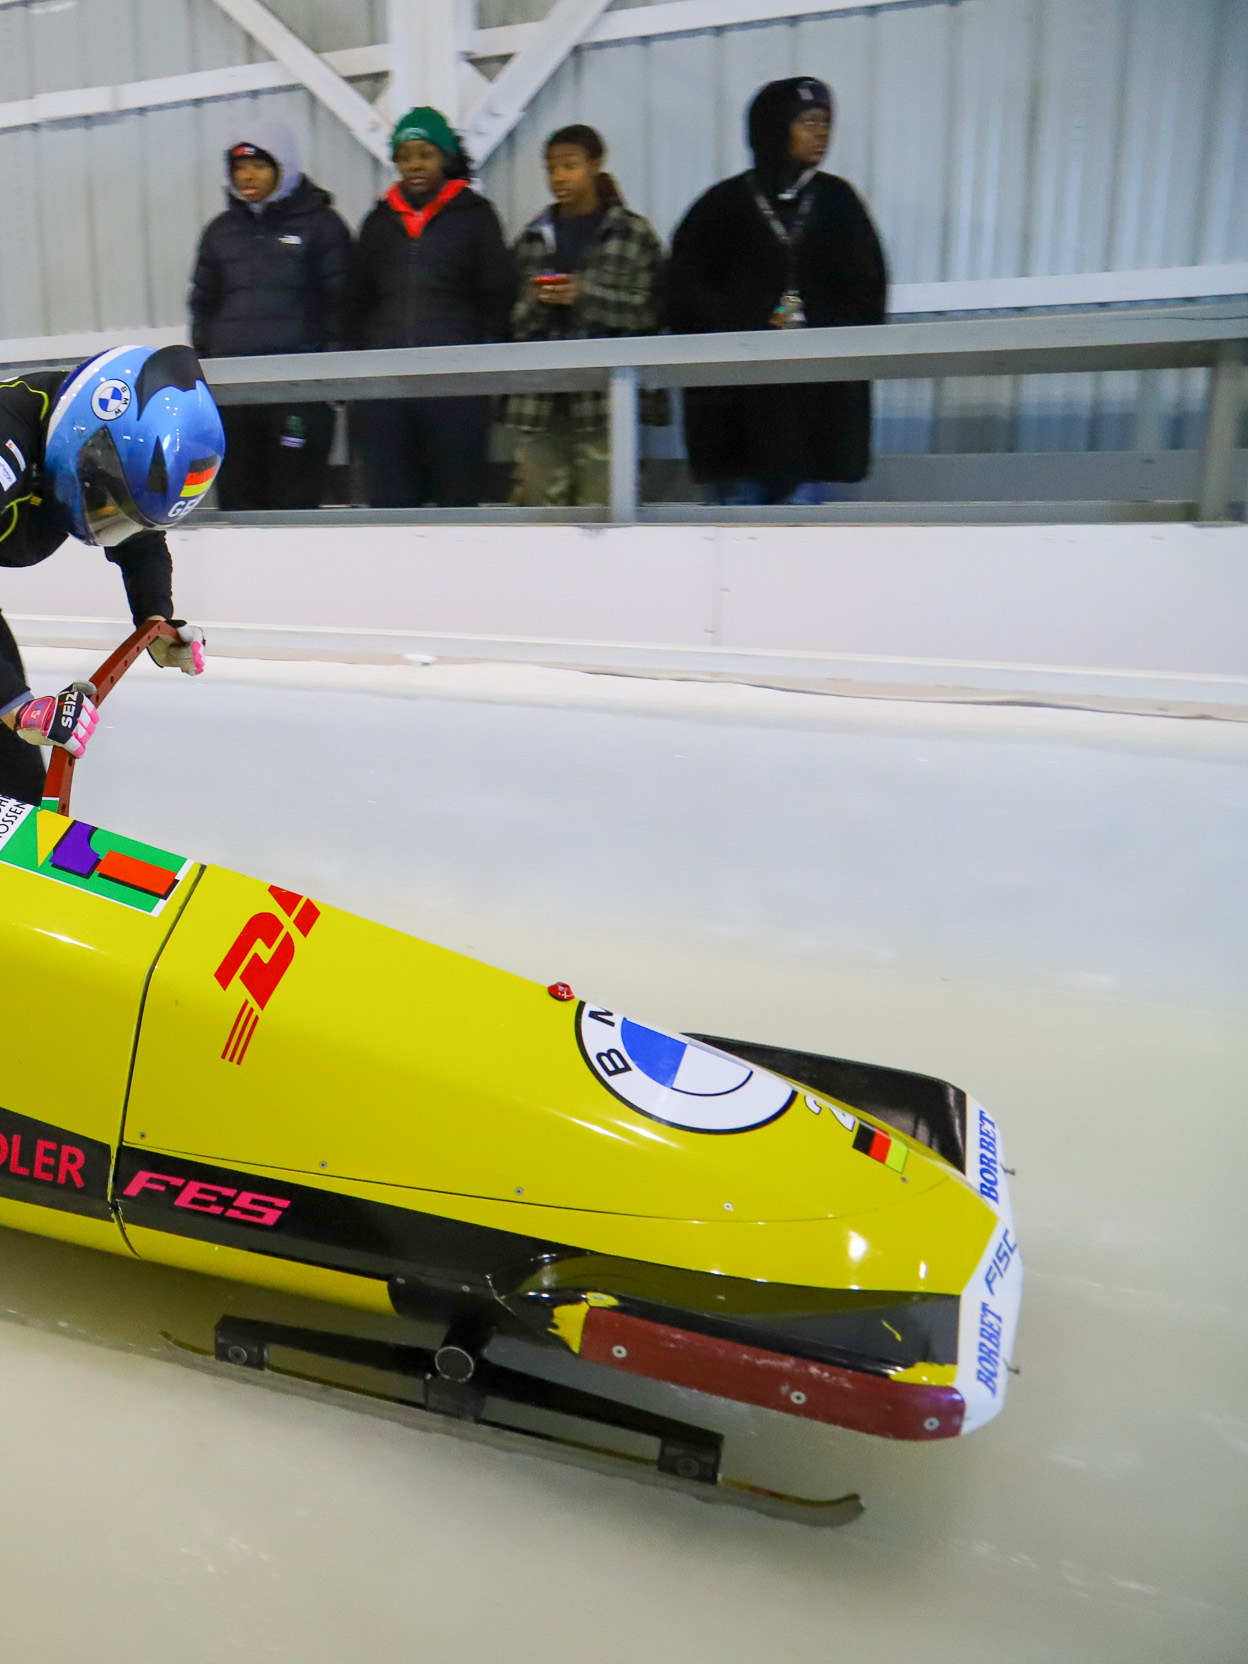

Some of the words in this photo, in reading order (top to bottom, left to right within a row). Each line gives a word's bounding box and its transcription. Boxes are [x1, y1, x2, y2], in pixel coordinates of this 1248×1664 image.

[61, 691, 79, 729] SEIZ
[978, 1109, 999, 1205] BORBET
[122, 1170, 292, 1226] FES
[975, 1302, 1004, 1399] BORBET
